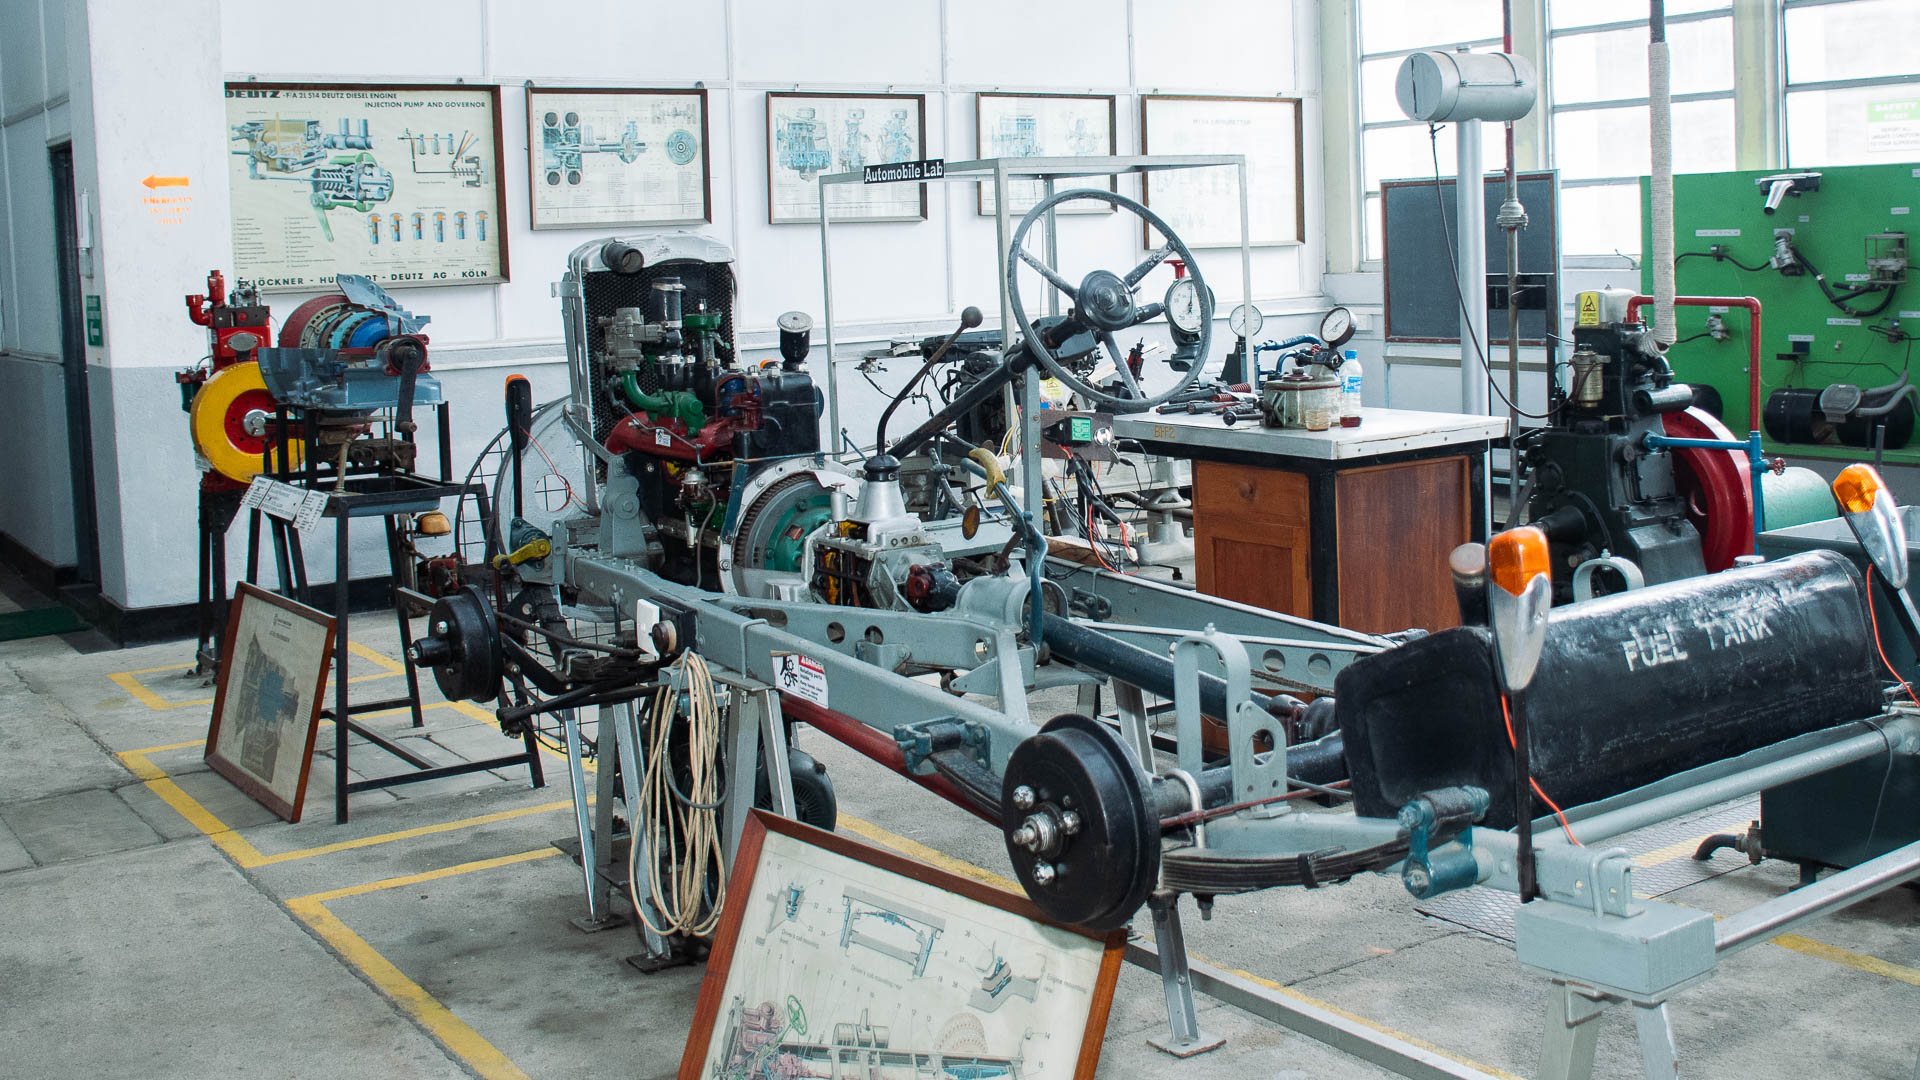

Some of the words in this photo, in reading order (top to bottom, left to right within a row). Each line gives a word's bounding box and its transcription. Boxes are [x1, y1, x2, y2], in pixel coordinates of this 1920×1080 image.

[225, 90, 281, 98] DEUTZ
[864, 163, 921, 183] Automobile
[923, 161, 944, 178] Lab
[390, 272, 424, 281] DEUTZ
[432, 271, 448, 279] AG
[461, 269, 488, 278] KÖLN
[1621, 618, 1689, 672] FUEL
[1694, 615, 1774, 650] TANK
